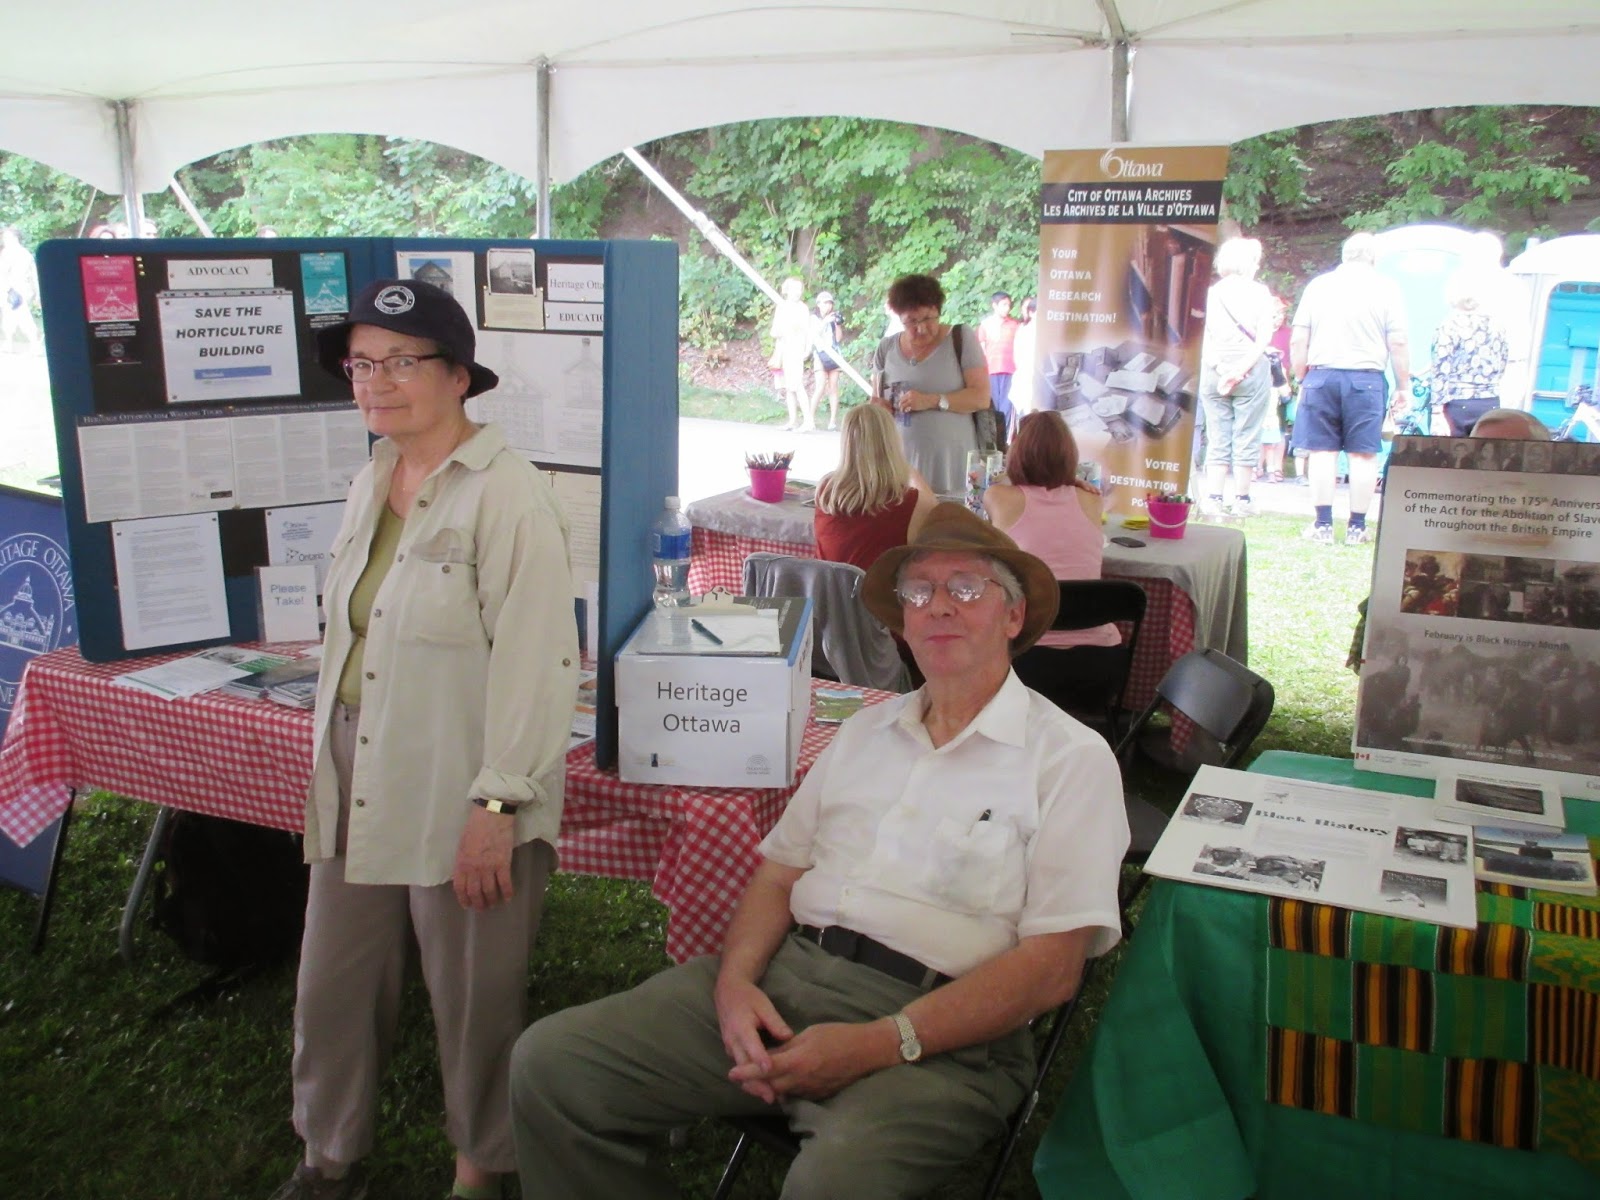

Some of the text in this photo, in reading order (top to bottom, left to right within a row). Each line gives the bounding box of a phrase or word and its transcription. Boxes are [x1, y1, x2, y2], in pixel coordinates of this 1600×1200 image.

[1100, 148, 1164, 179] Ottawa
[1067, 187, 1192, 202] CITY OF OTTAWA ARCHIVES
[1043, 202, 1216, 217] LES ARCHIVES DE LA VILLE D'OTTAWA
[1052, 247, 1078, 259] YOUR
[187, 266, 250, 276] ADVOCACY
[1049, 269, 1092, 281] OTTAWA
[550, 278, 585, 292] Heritage
[1048, 289, 1102, 302] RESEARCH
[194, 306, 263, 319] SAVE THE
[1047, 310, 1117, 324] DESTINATION!
[176, 324, 284, 339] HORTICULTURE
[199, 344, 266, 358] BUILDING
[1145, 458, 1180, 472] VOTRE
[1109, 475, 1178, 492] DESTINATION
[1404, 489, 1495, 506] Commemorating
[1498, 494, 1517, 505] the
[1404, 503, 1416, 513] of
[1419, 504, 1437, 514] the
[1439, 505, 1458, 516] Act
[1461, 506, 1478, 517] for
[1481, 507, 1499, 518] the
[1501, 509, 1554, 521] Abolition
[1558, 511, 1570, 522] of
[1424, 518, 1593, 539] throughout the British Empire
[0, 539, 40, 566] ITAGE
[298, 552, 325, 562] Ontario
[270, 584, 307, 594] Please
[275, 596, 305, 607] Take!
[1424, 629, 1464, 643] February
[1476, 634, 1500, 645] Black
[1538, 640, 1570, 651] Month
[657, 681, 748, 708] Heritage
[663, 713, 741, 734] Ottawa
[1256, 810, 1391, 836] Black History
